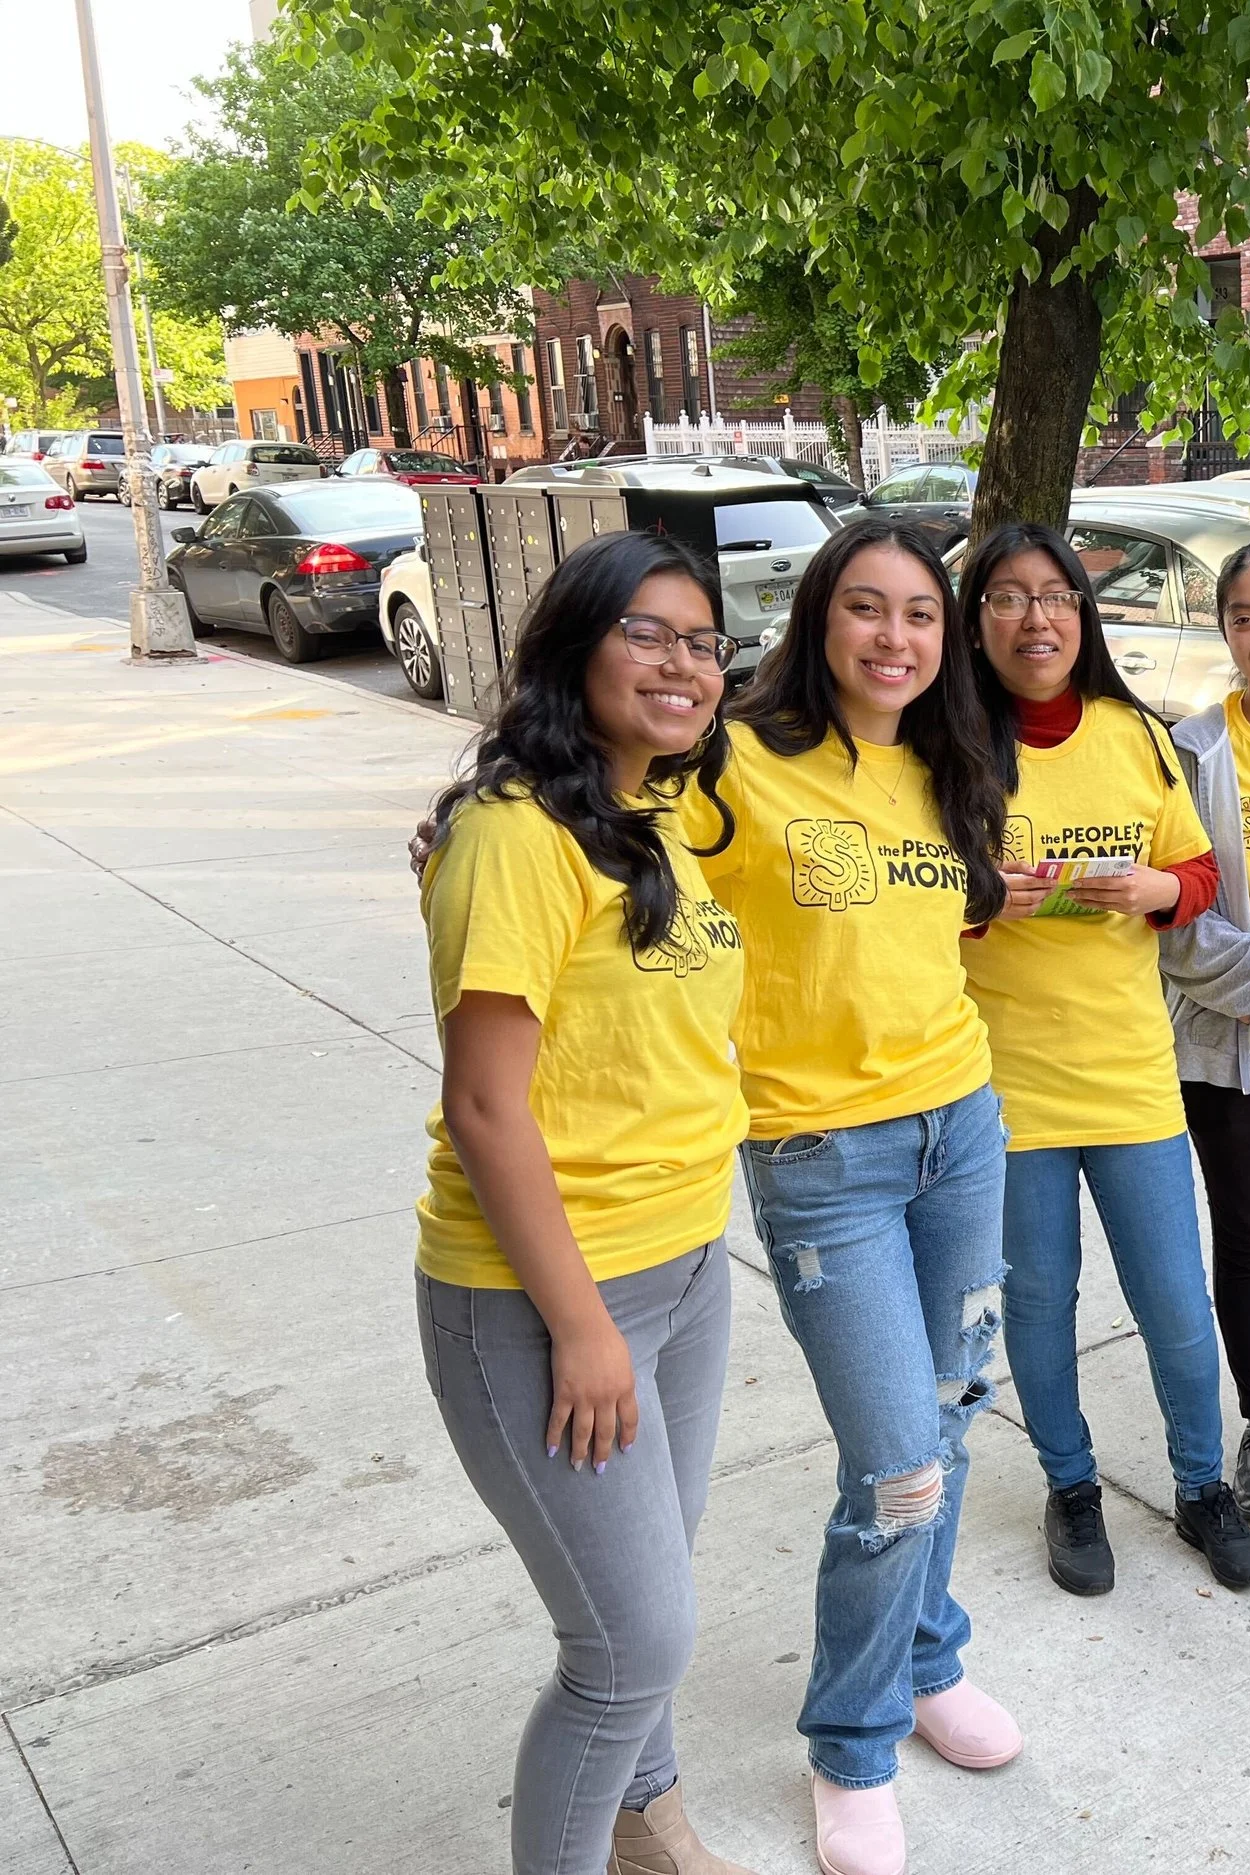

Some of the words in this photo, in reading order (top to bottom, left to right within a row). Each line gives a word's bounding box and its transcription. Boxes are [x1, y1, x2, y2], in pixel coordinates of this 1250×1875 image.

[877, 844, 899, 857] the
[902, 839, 965, 865] PEOPL
[1041, 834, 1061, 844] the
[887, 860, 967, 895] MONE
